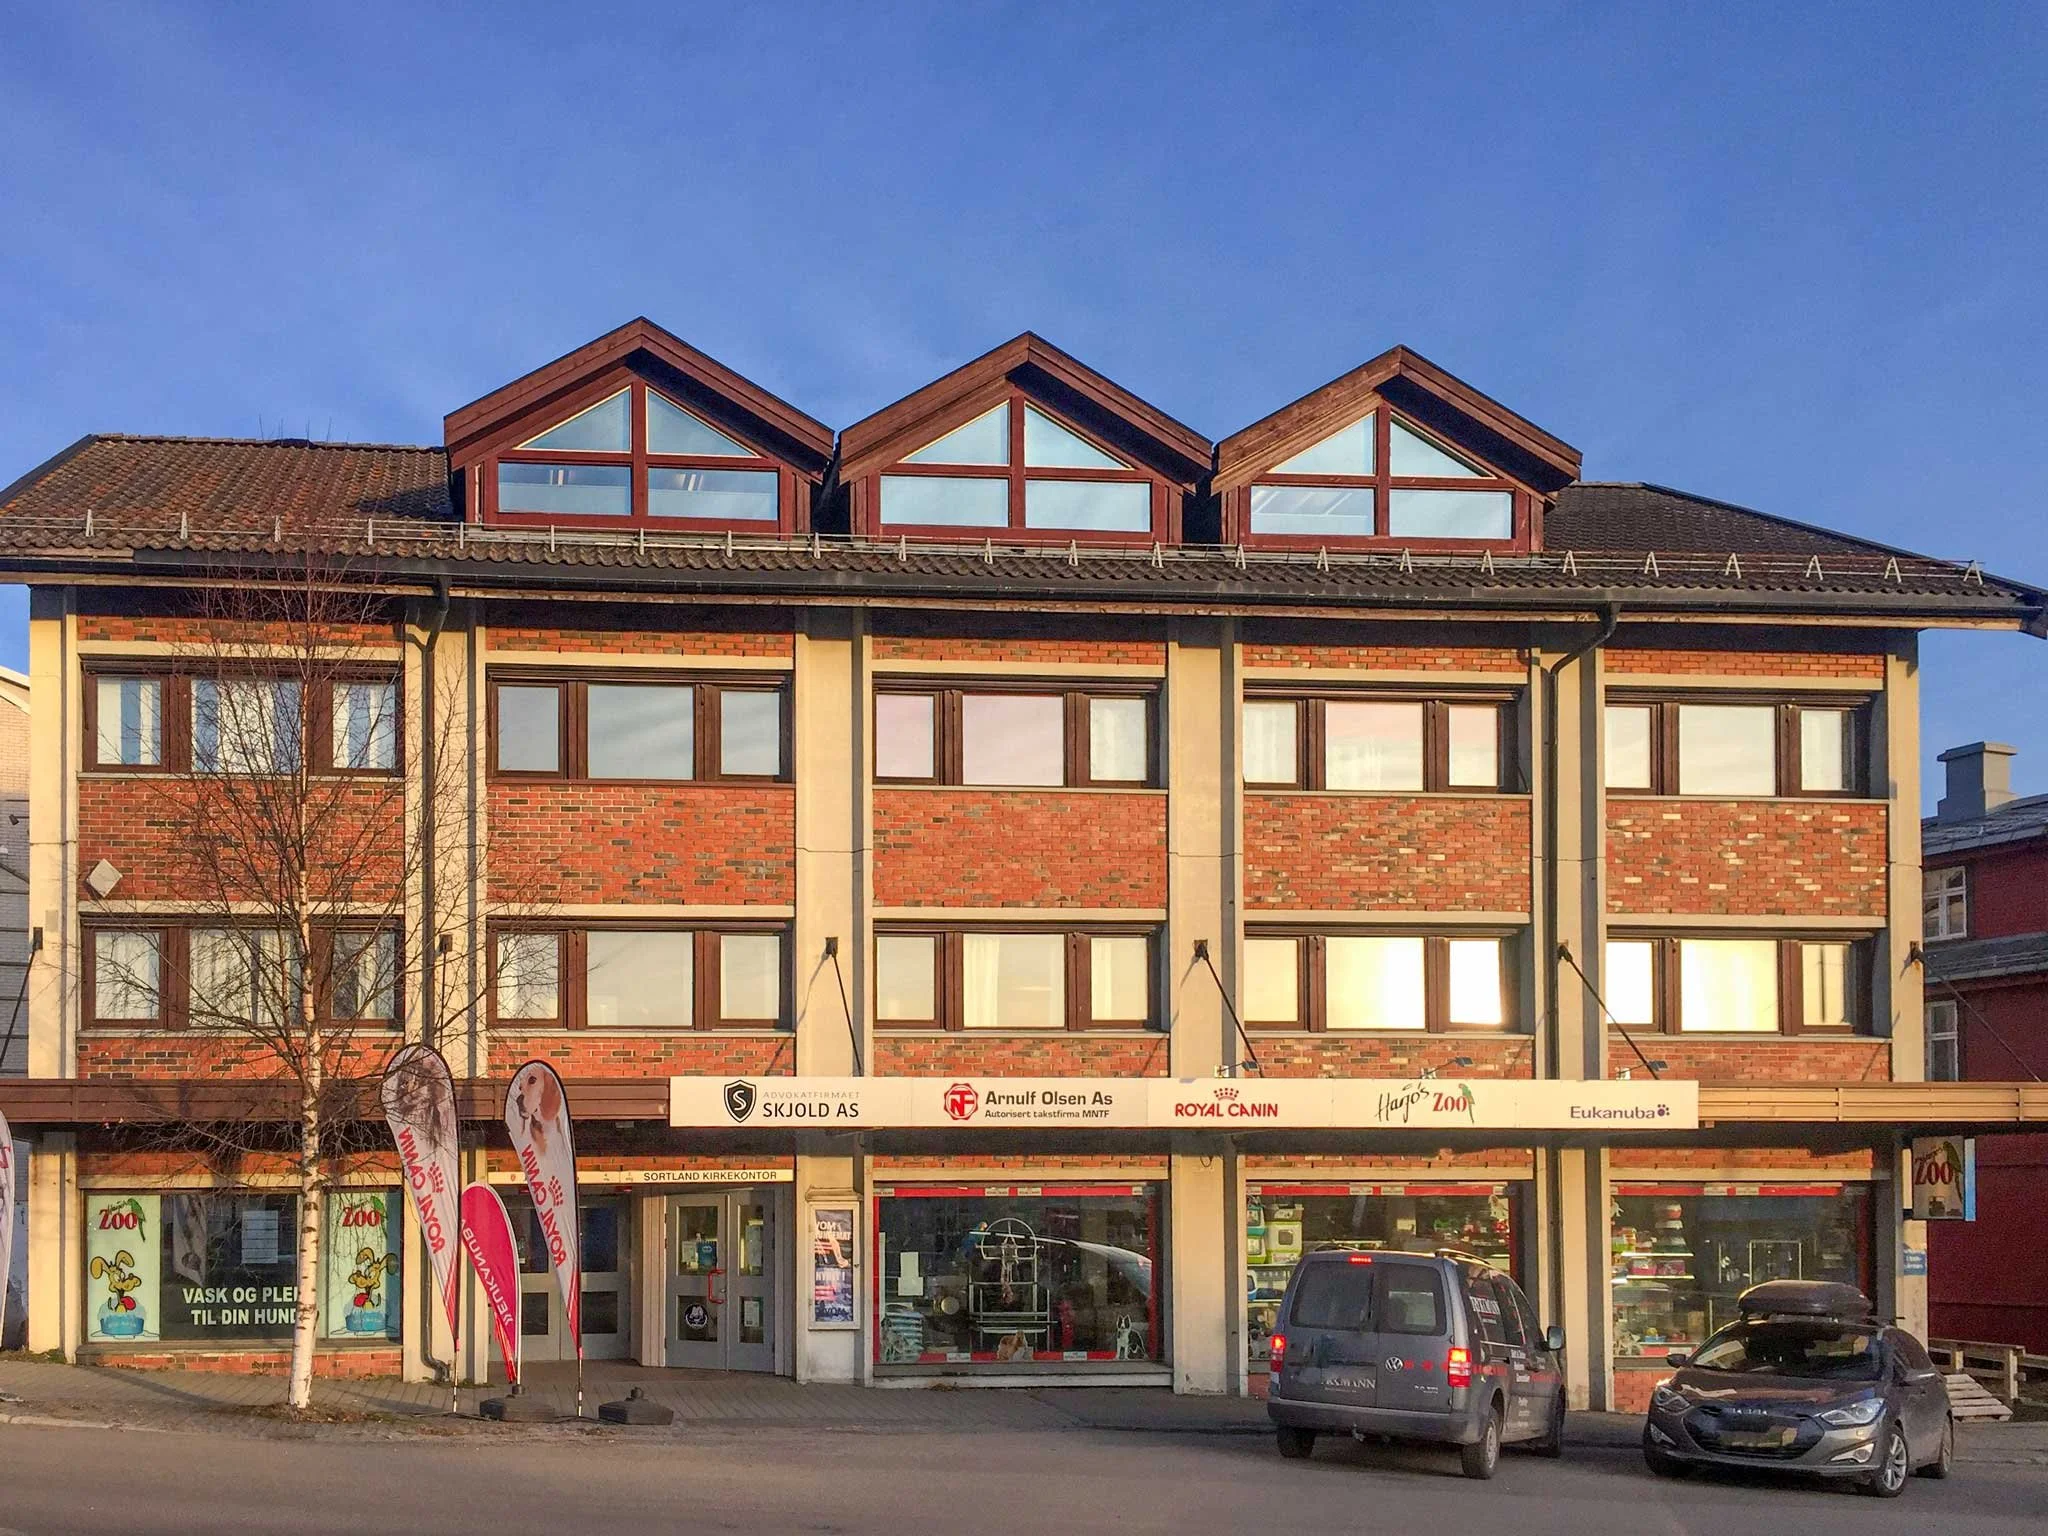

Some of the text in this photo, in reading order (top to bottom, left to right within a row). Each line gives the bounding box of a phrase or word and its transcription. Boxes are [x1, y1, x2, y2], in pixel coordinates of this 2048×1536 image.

[763, 1091, 861, 1099] ADVOKATFIRMAET
[985, 1091, 1113, 1105] Arnulf Olsen As
[763, 1102, 859, 1118] SKJOLD AS
[984, 1109, 1110, 1118] Autorisert takstfirma MNTF
[1175, 1103, 1278, 1117] ROYAL CANIN
[1570, 1106, 1656, 1119] Eukanuba
[643, 1171, 777, 1181] SORTLAND KIRKEKONTOR
[182, 1286, 299, 1304] VASK OG PLEI
[190, 1309, 216, 1325] TIL
[221, 1309, 249, 1325] DIN
